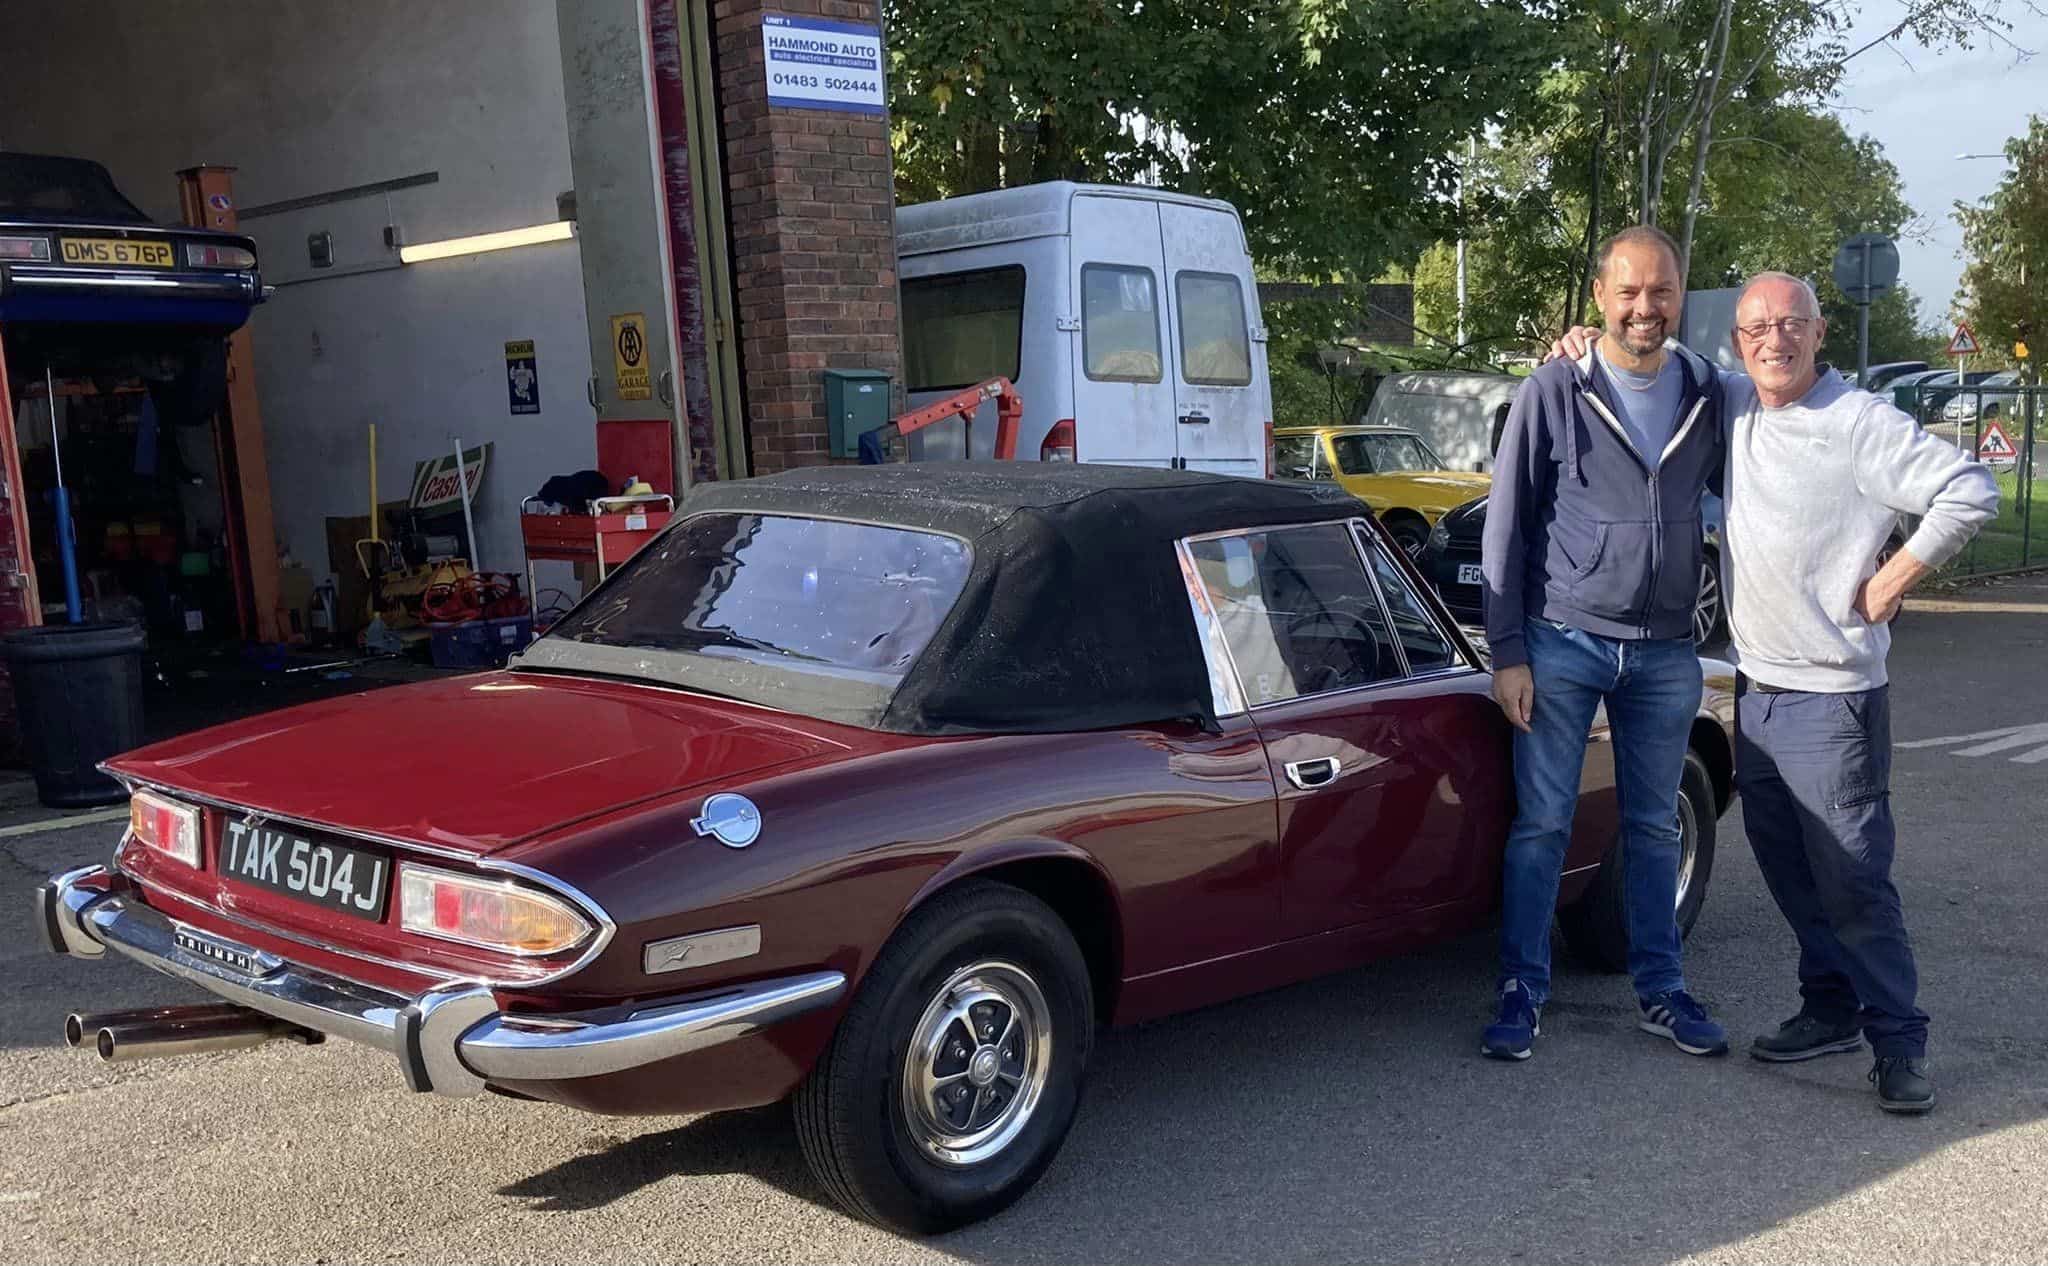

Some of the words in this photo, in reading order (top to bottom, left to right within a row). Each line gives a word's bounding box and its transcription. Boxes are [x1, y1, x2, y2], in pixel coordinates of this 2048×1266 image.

[766, 16, 783, 24] UNIT
[768, 36, 838, 54] HAMMOND
[842, 45, 876, 57] AUTO
[794, 53, 831, 64] electrical
[833, 57, 873, 68] specialists
[773, 73, 818, 87] 01483
[824, 78, 877, 92] 502444
[114, 244, 169, 263] 676P
[1464, 567, 1482, 581] FG
[229, 822, 284, 885] TAK
[287, 840, 382, 911] 504J
[177, 935, 245, 967] TRIUMPH
